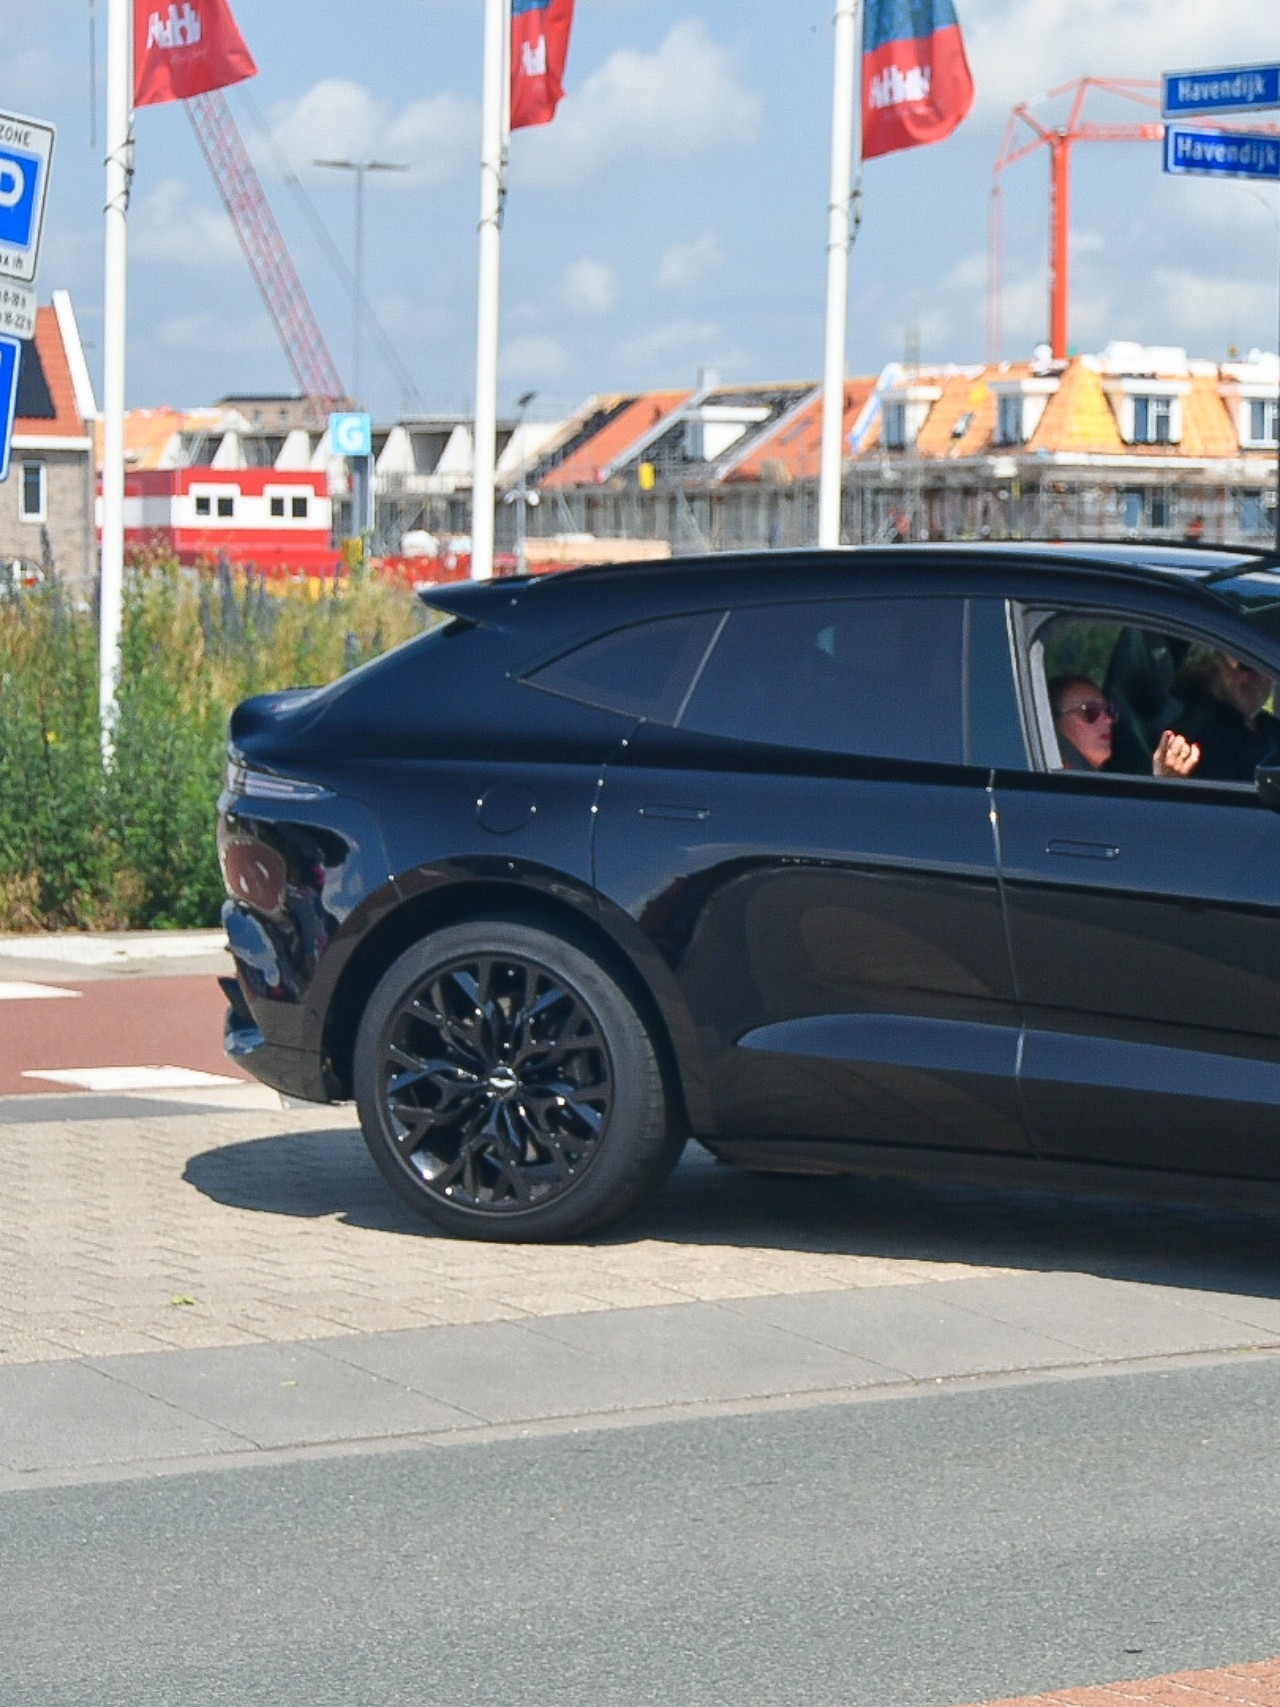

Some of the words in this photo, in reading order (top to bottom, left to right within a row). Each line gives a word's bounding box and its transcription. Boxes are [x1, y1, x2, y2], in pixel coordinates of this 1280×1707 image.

[1178, 73, 1265, 102] Havendijk
[1177, 135, 1276, 171] Havendijk
[338, 416, 364, 451] G
